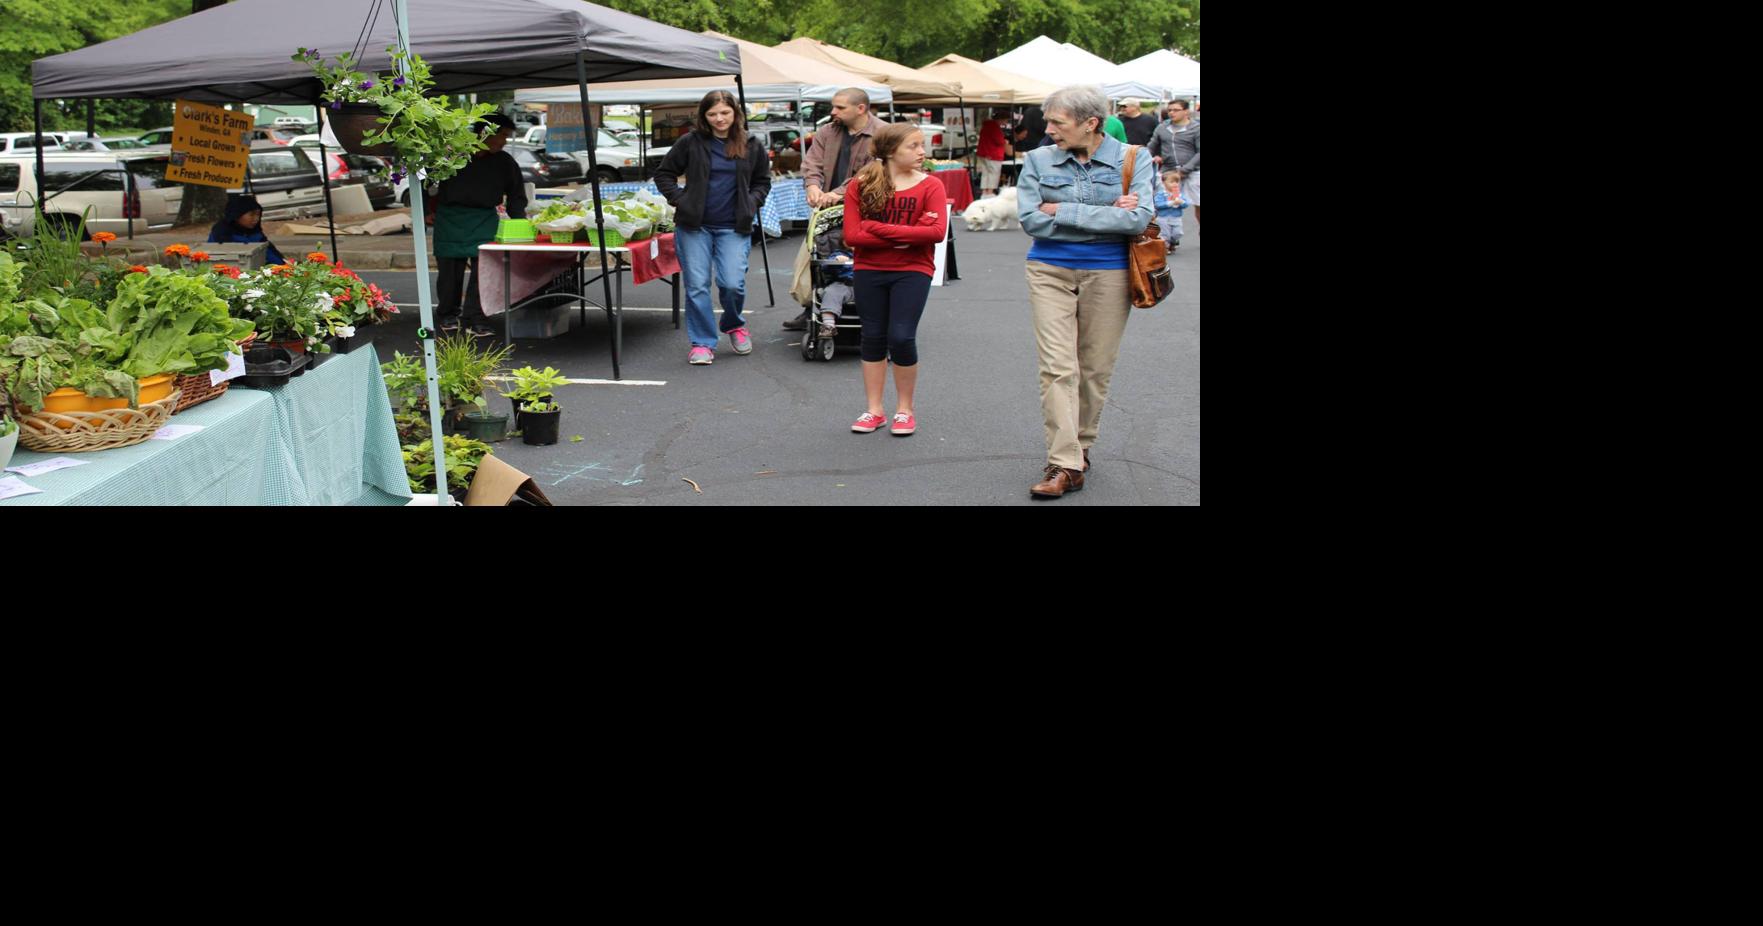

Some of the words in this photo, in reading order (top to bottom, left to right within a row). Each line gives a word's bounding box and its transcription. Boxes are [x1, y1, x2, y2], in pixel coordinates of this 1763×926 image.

[222, 113, 249, 131] Farm
[189, 136, 211, 149] Local
[212, 140, 236, 153] Grown
[207, 155, 236, 169] Flowers
[179, 168, 202, 179] Fresh
[203, 171, 233, 184] Produce
[880, 208, 914, 225] WIFT
